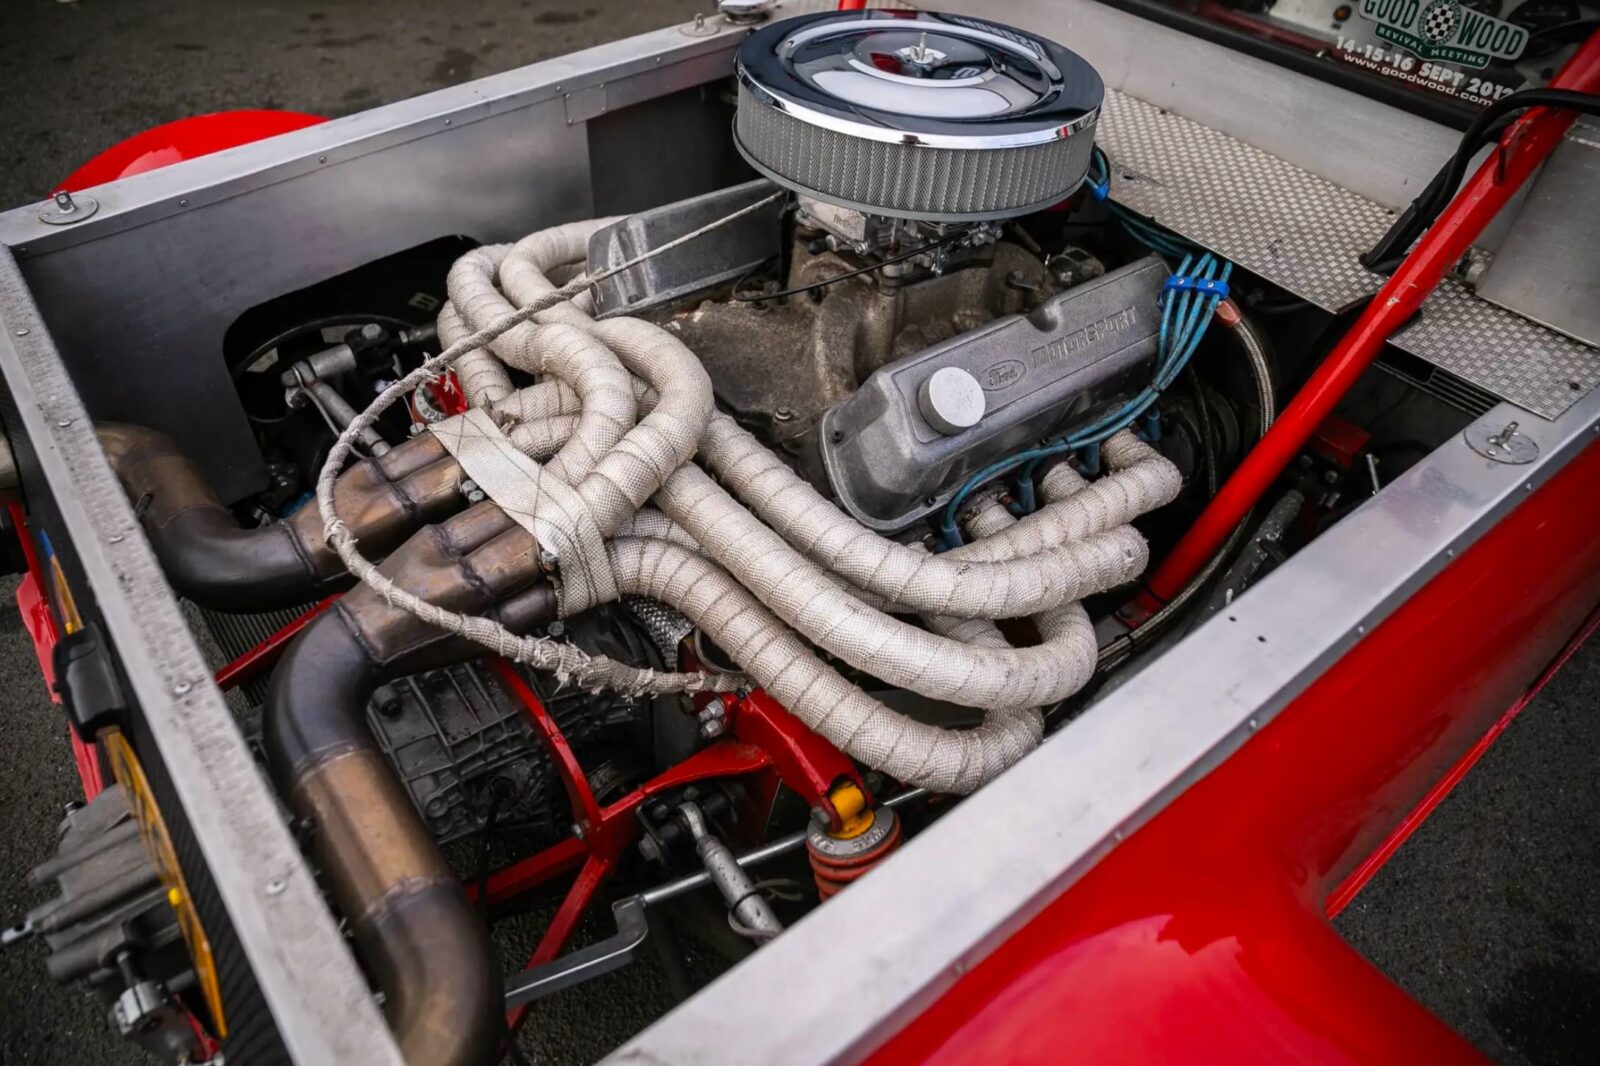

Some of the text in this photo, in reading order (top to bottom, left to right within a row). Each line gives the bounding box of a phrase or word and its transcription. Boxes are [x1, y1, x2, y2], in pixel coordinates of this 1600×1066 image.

[1379, 27, 1485, 64] REVIVAL MEETING
[1457, 12, 1523, 56] WOOD
[1344, 54, 1492, 107] www.goodwood.com
[1418, 62, 1464, 87] SEPT
[1032, 305, 1136, 369] MOTORSPORT
